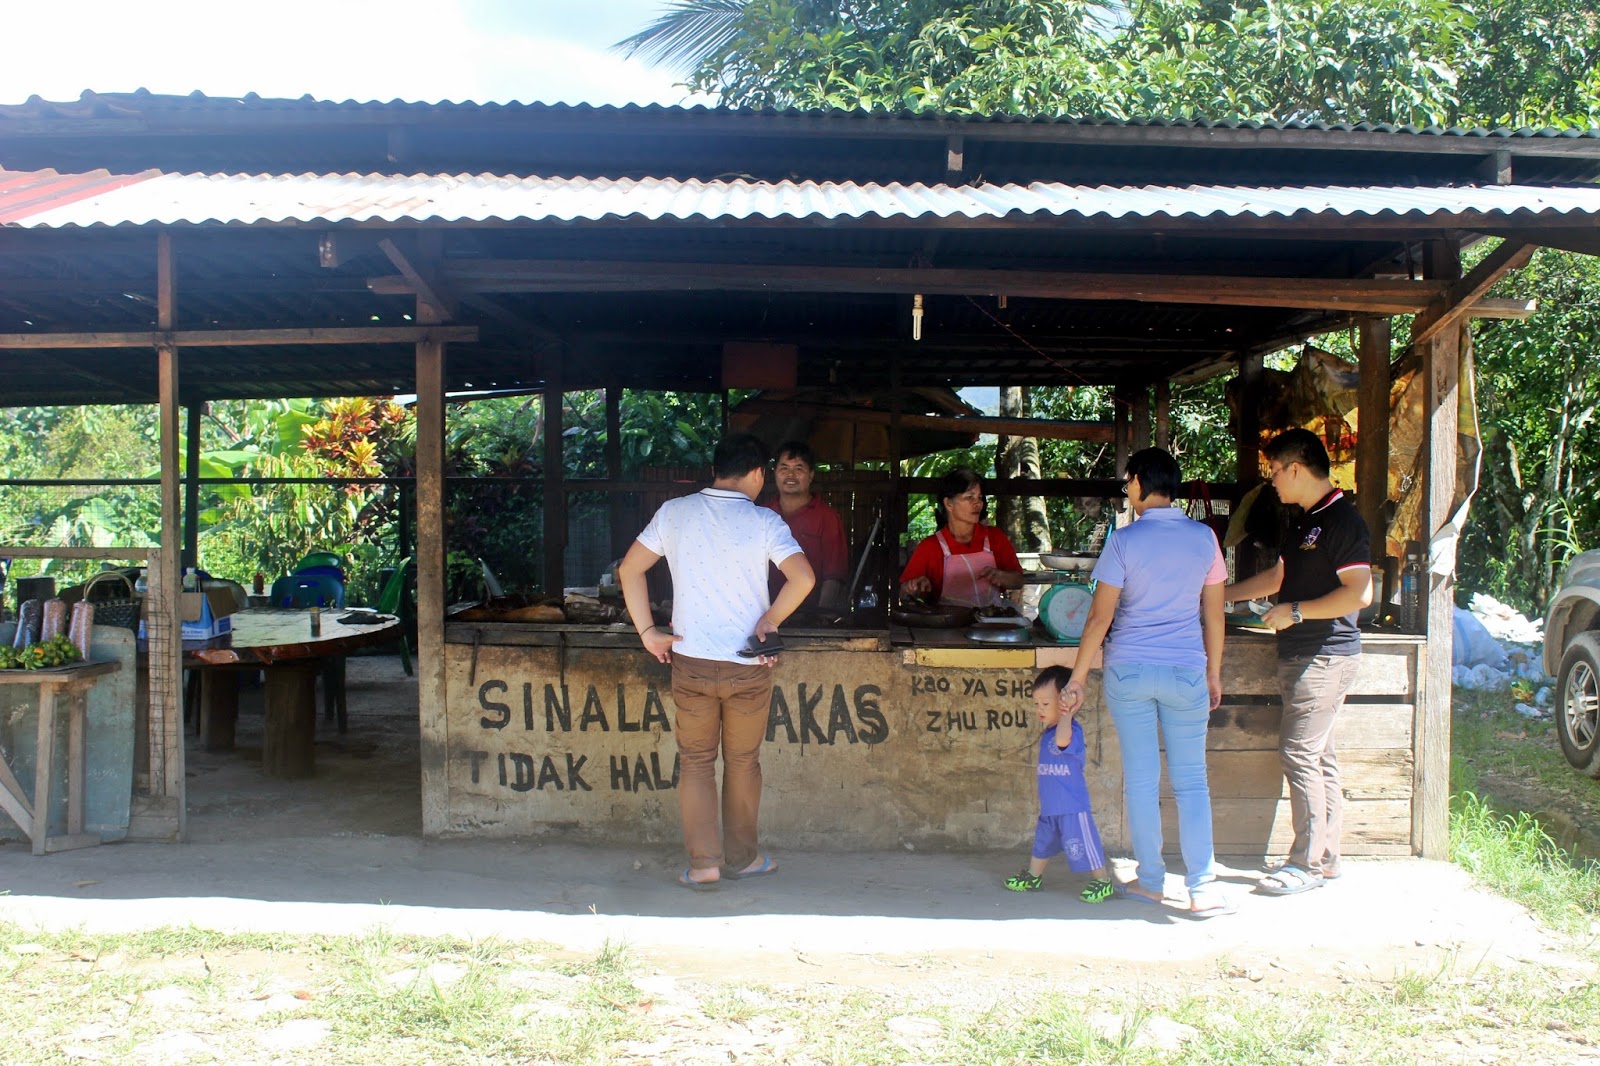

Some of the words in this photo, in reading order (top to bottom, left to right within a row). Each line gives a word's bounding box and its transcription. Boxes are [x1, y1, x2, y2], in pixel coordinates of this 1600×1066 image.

[962, 678, 988, 697] YA
[478, 679, 672, 732] SINALA
[765, 683, 889, 745] AKAS
[926, 710, 977, 732] ZHU
[986, 709, 1028, 731] ROU
[461, 750, 593, 792] TIDAK
